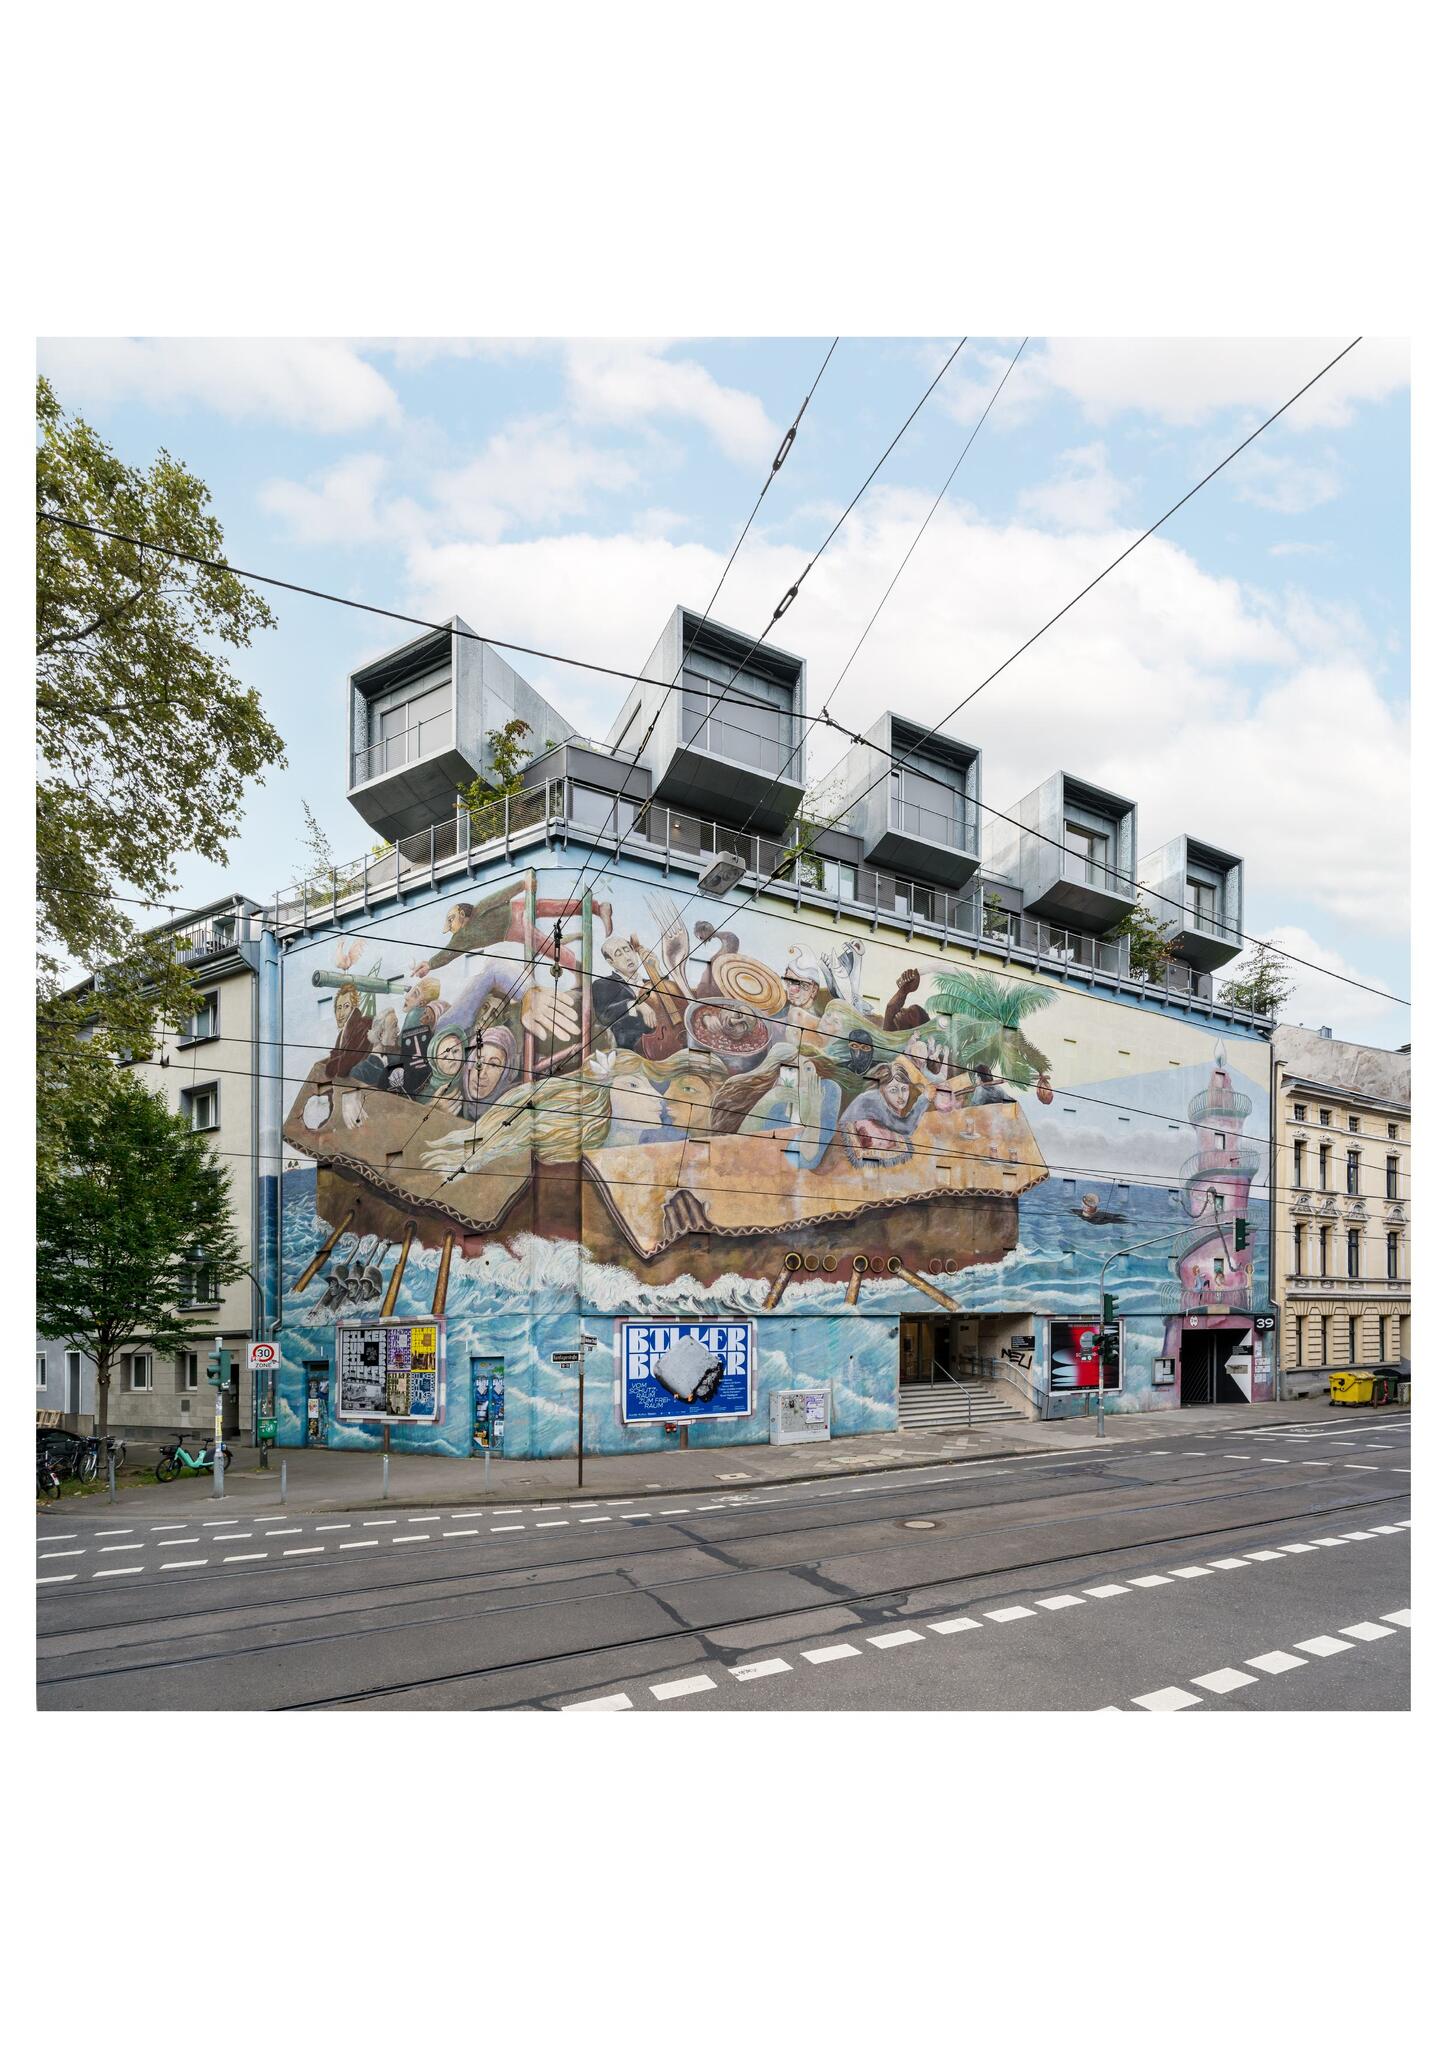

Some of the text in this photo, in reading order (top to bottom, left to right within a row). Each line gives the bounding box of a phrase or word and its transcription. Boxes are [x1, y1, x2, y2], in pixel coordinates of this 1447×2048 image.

[1256, 1318, 1274, 1329] 39
[343, 1330, 387, 1343] BILKER
[257, 1348, 270, 1358] 30
[343, 1342, 364, 1354] BUN
[1001, 1348, 1033, 1369] NEU
[629, 1387, 658, 1395] SCHUTZ-
